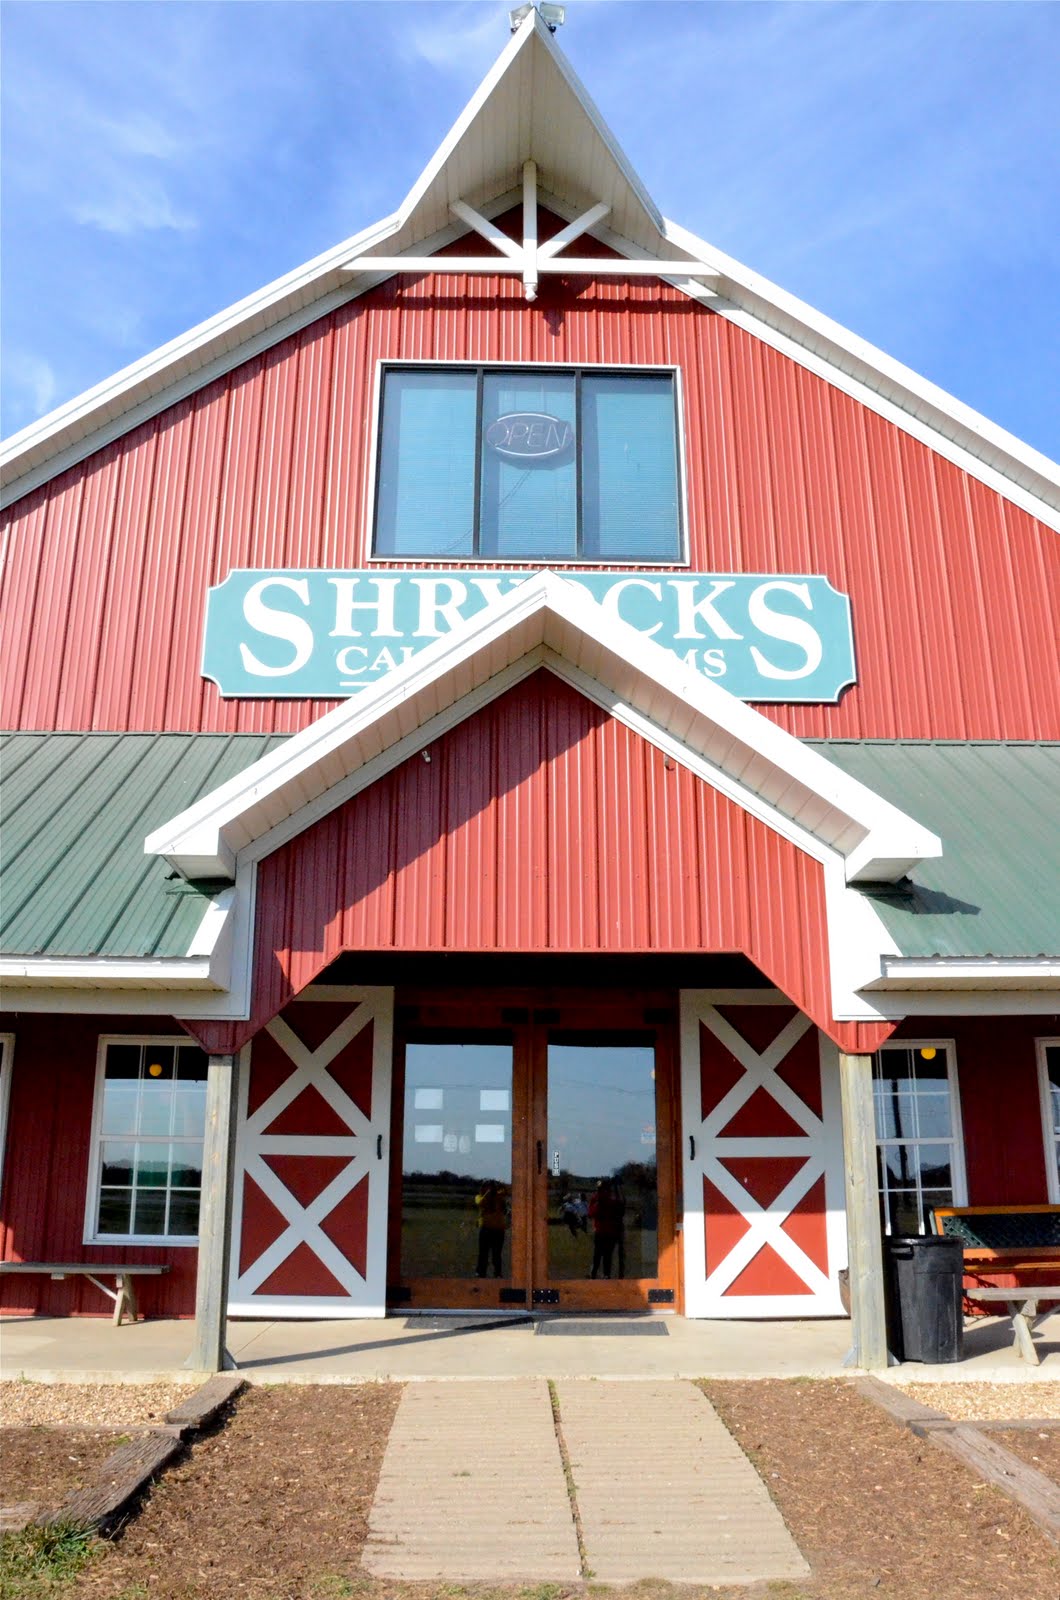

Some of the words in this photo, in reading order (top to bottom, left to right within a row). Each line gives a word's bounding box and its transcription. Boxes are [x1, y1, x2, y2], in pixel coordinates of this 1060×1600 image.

[487, 421, 568, 448] OPEN
[239, 576, 823, 681] SHRCKS
[552, 1151, 560, 1176] PUSH
